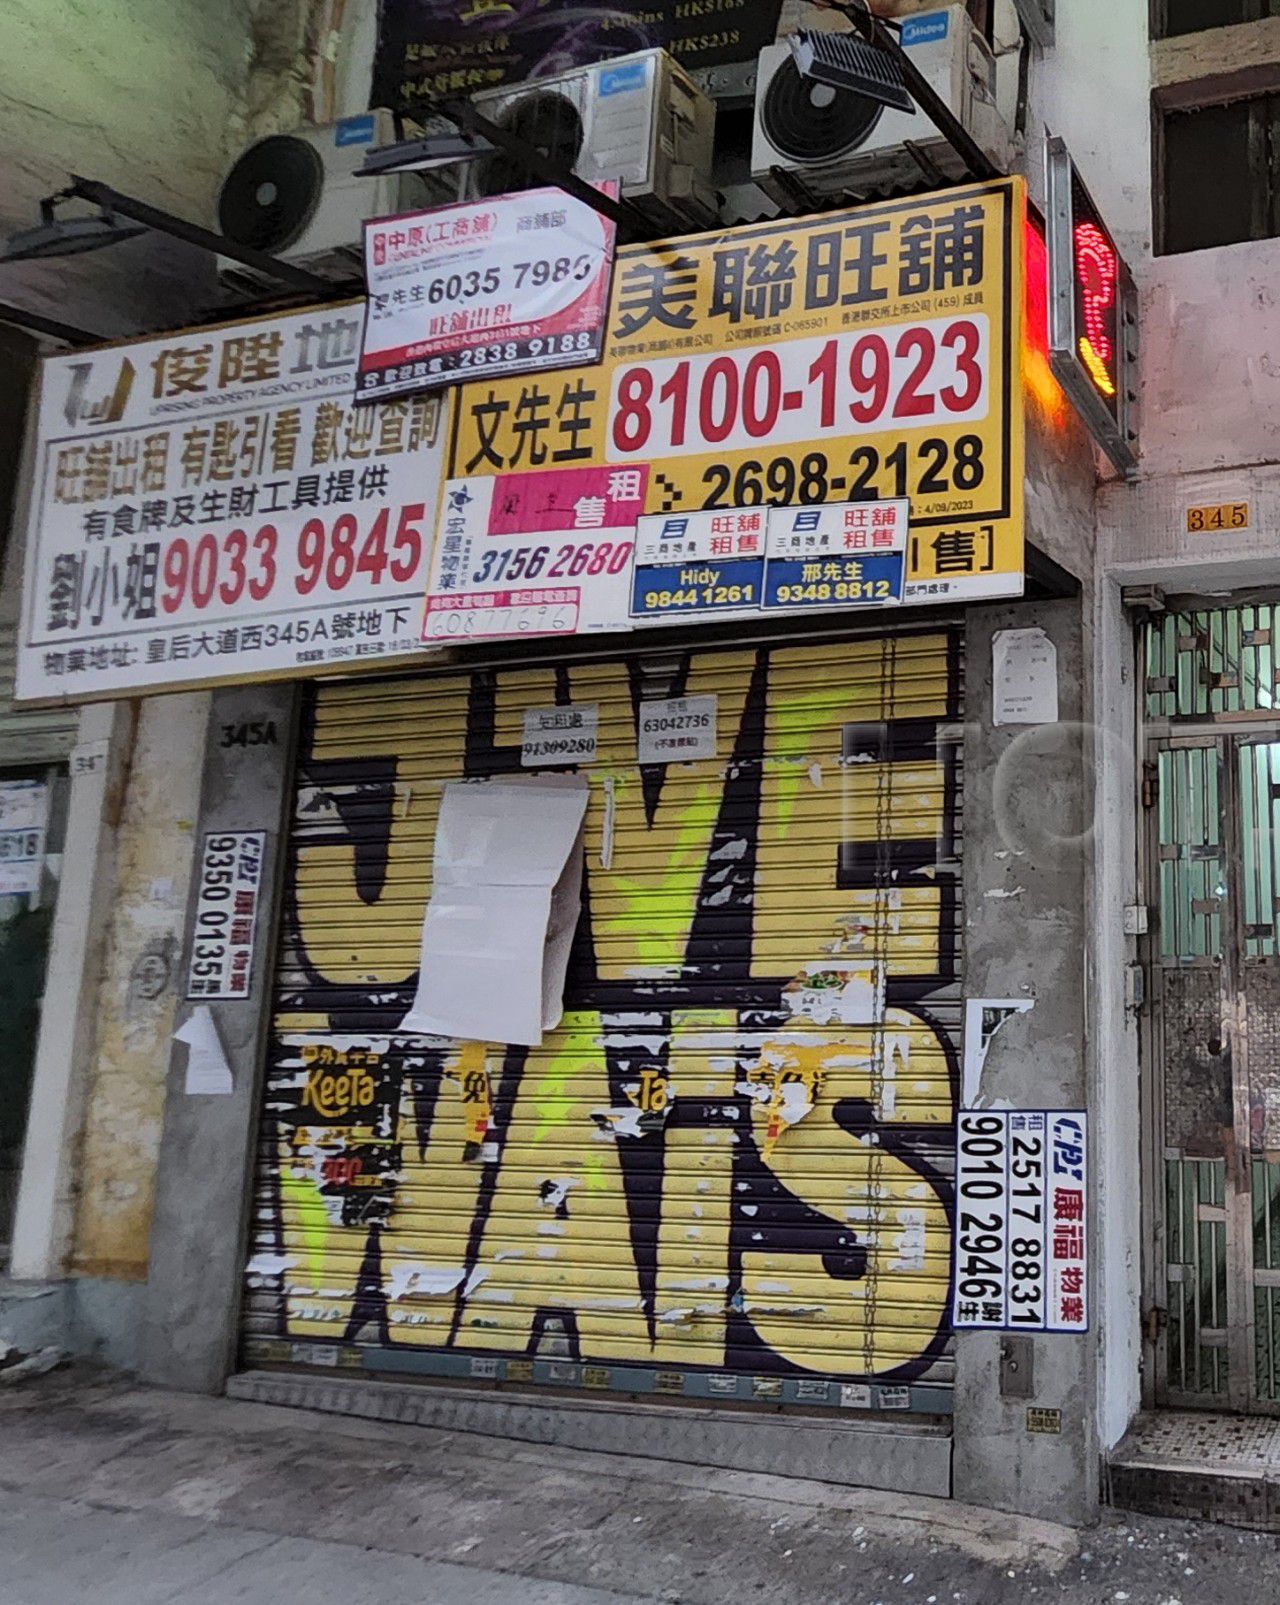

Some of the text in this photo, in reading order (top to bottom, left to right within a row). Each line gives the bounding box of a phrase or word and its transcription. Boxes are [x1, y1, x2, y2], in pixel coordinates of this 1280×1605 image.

[428, 267, 501, 304] 6035
[459, 342, 519, 368] 2838
[527, 332, 592, 358] 9188
[305, 372, 352, 391] LIMITED
[465, 381, 598, 476] 文先生
[612, 319, 983, 454] 8100-1923
[180, 406, 302, 489] 有匙引看
[310, 397, 443, 469] 歡迎查詢
[701, 434, 985, 508] 2698-2128
[83, 463, 389, 543] 有食牌及生財工具提供
[1191, 504, 1248, 531] 345
[47, 542, 162, 632] 劉小姐
[161, 523, 279, 614] 9033
[294, 502, 425, 595] 9845
[472, 545, 550, 584] 3156
[547, 541, 634, 578] 2680
[709, 534, 759, 556] 租售
[842, 528, 895, 550] 租售
[645, 584, 753, 609] 9844 1261
[680, 568, 721, 587] Hidy
[776, 580, 890, 603] 9348 8812
[145, 605, 412, 665] 皇后大道西345A號地下
[643, 712, 710, 733] 63042736
[201, 836, 238, 903] 9350
[192, 910, 229, 977] 0135
[959, 1116, 1004, 1200] 9010
[1010, 1136, 1043, 1225] 2517
[957, 1211, 1004, 1299] 2946
[1010, 1237, 1043, 1325] 8831
